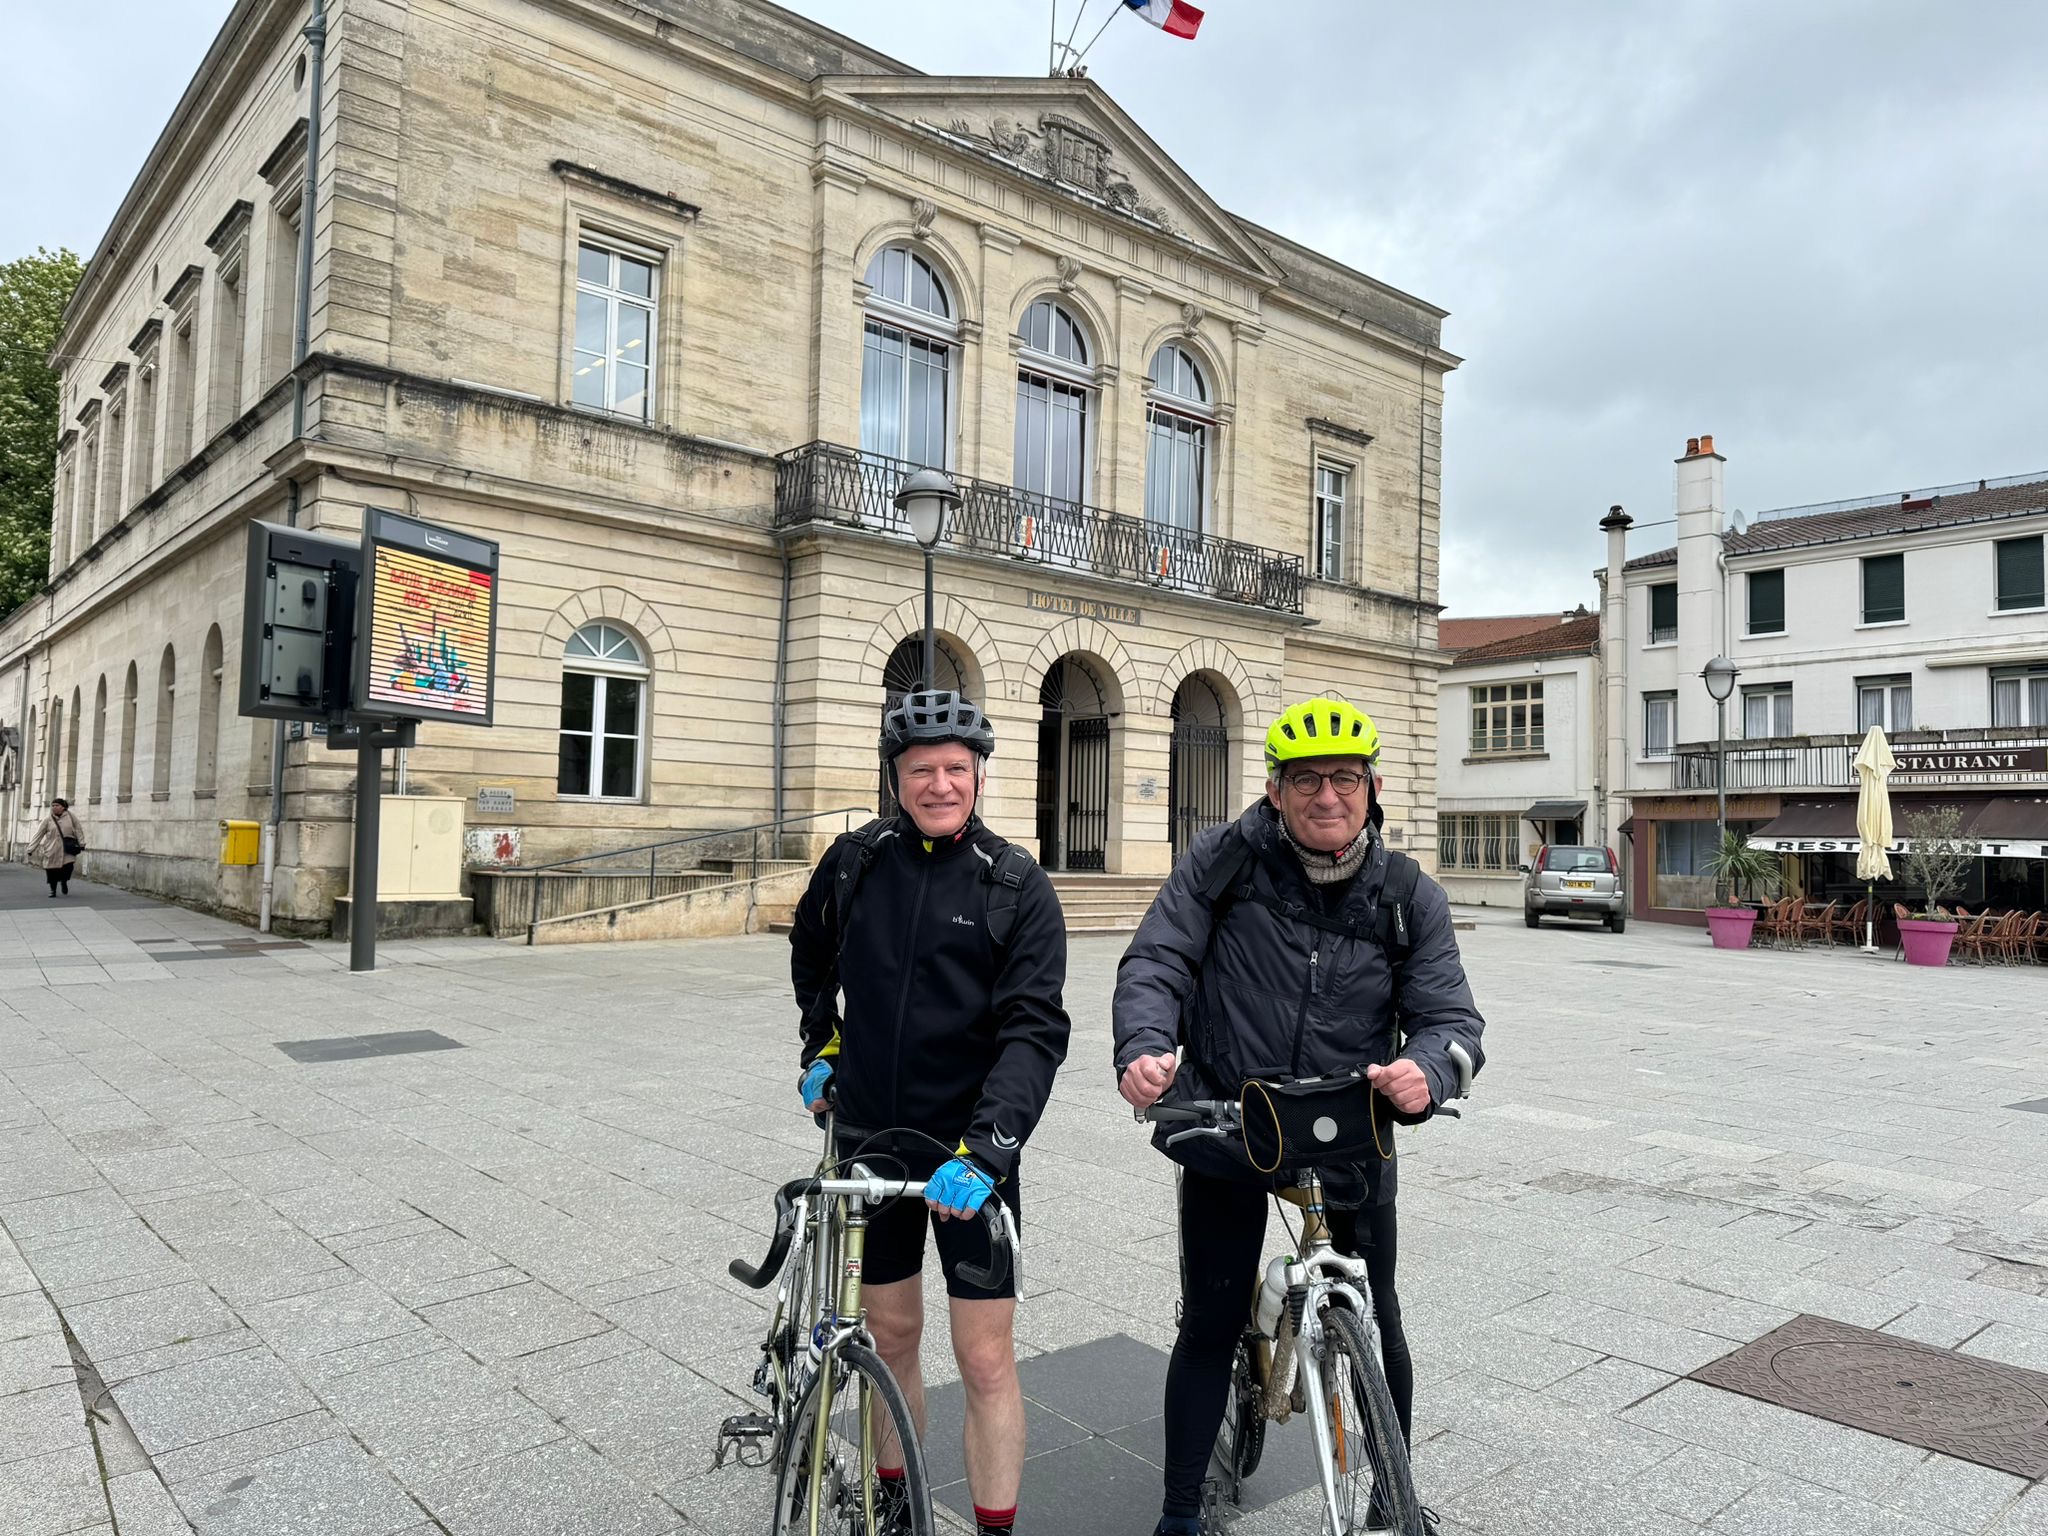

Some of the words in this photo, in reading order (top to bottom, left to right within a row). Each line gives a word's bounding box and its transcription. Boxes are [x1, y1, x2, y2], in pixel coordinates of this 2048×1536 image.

[1080, 600, 1097, 617] DE
[1100, 603, 1137, 623] VILLE
[1896, 754, 2019, 770] STAURANT
